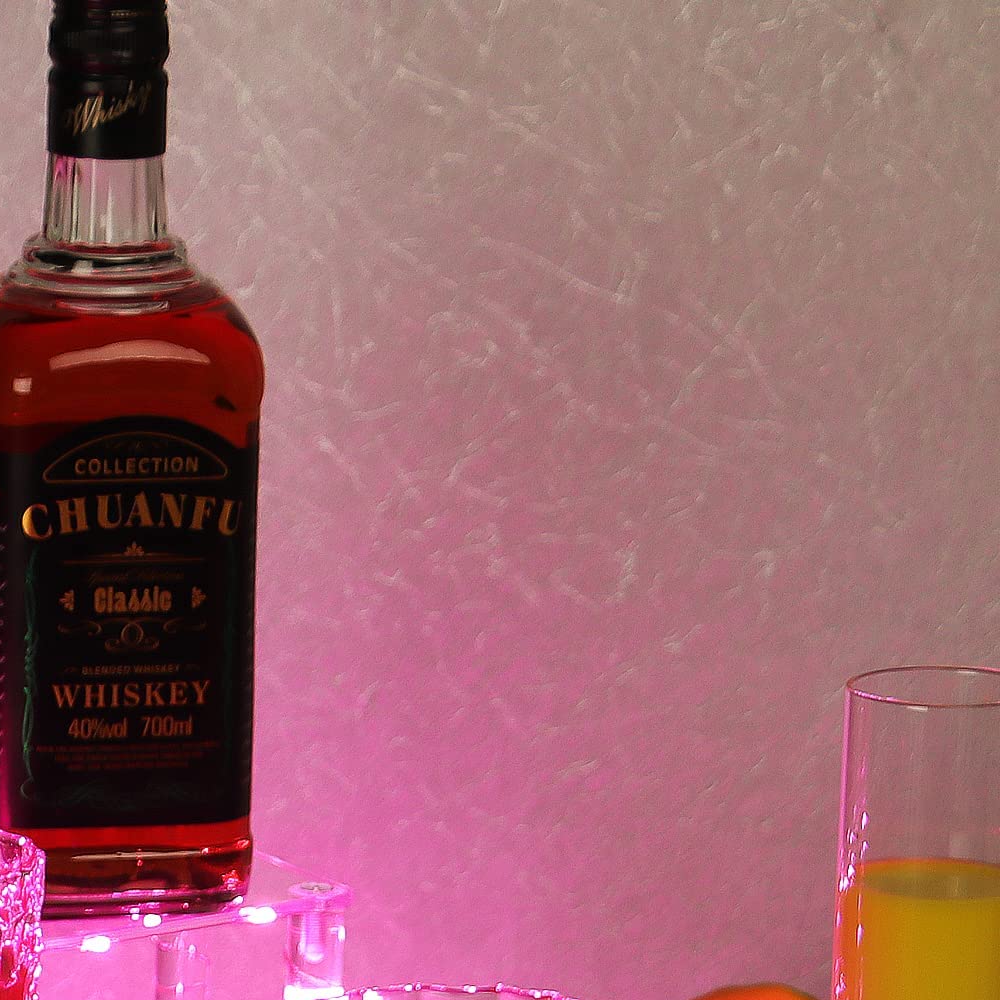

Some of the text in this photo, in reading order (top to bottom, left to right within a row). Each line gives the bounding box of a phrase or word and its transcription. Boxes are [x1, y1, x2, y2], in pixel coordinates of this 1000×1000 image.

[74, 456, 200, 475] COLLECTION
[21, 491, 243, 540] CHUANFU
[93, 585, 172, 614] Classic
[52, 679, 211, 709] WHISKEY
[68, 715, 193, 739] 40%vol 700ml
